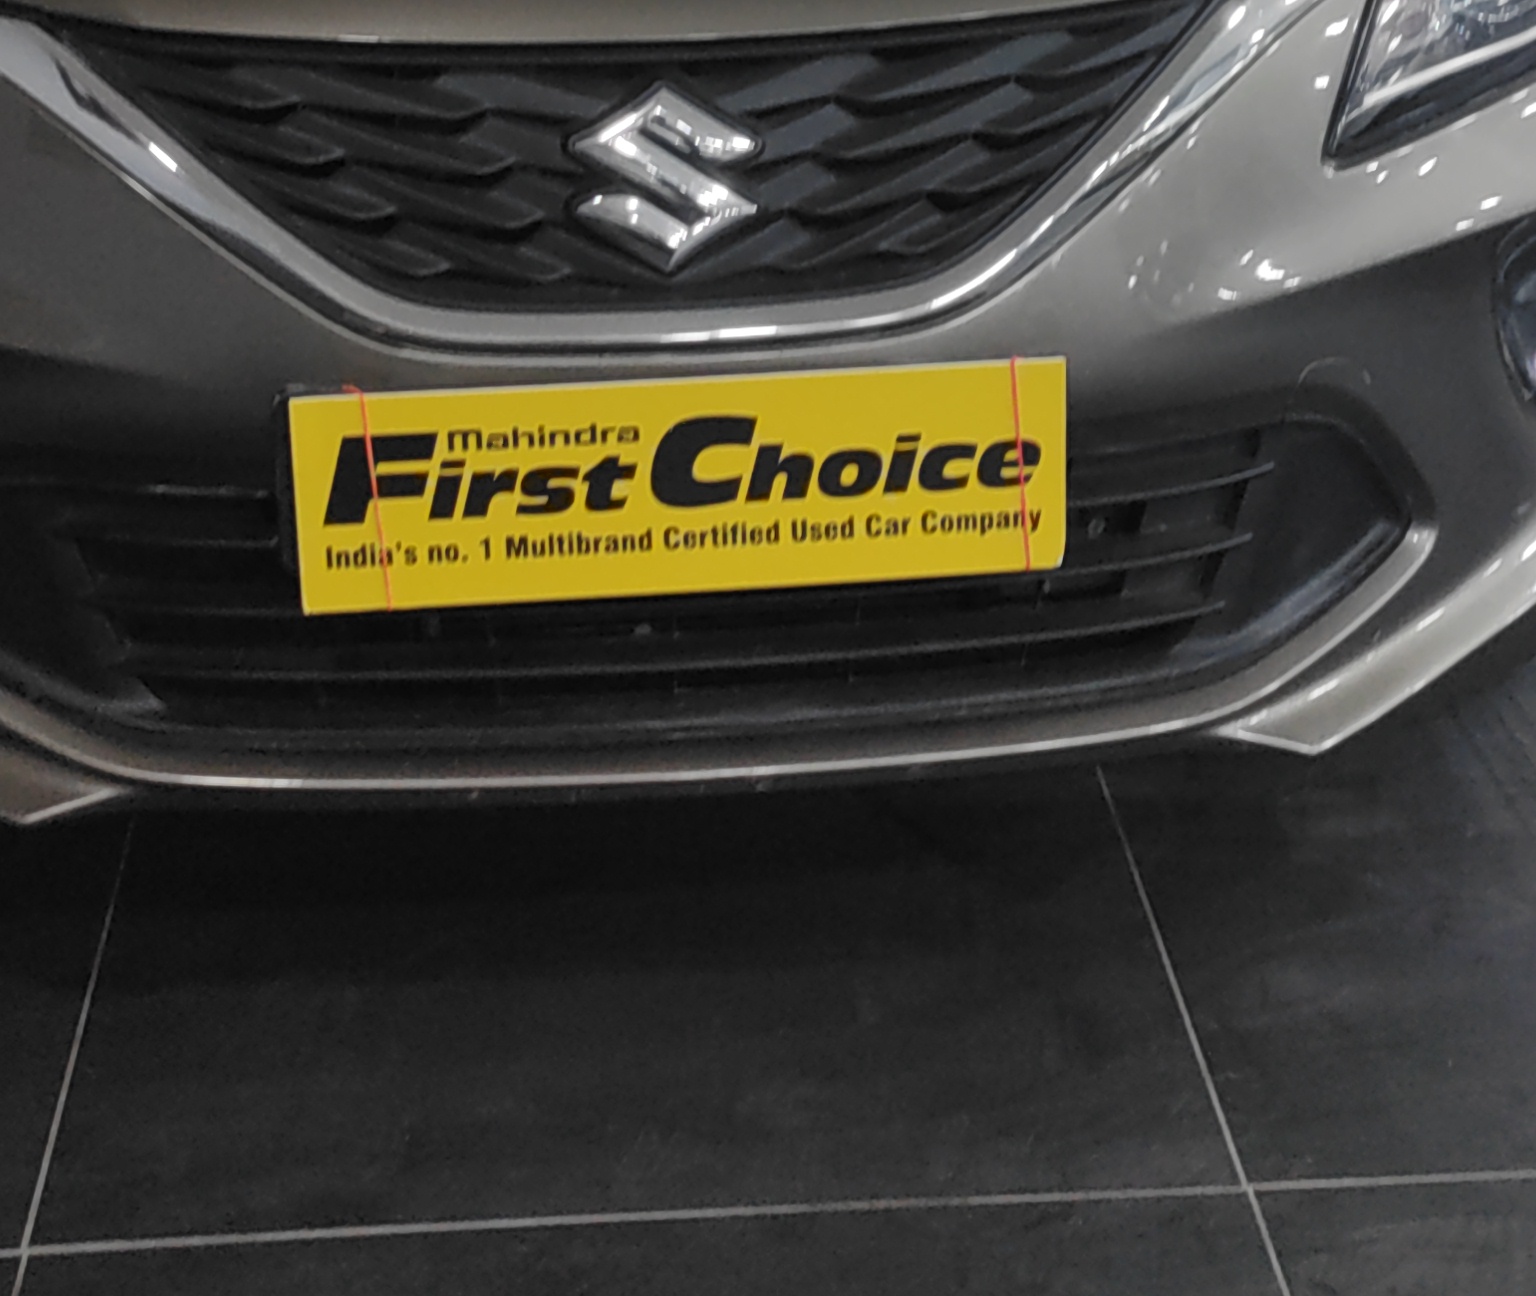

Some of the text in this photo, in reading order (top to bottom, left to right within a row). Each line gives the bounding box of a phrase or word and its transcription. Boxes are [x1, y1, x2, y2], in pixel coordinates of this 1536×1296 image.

[447, 423, 640, 453] Mahindra
[323, 414, 1042, 528] First Choice
[326, 507, 1042, 571] India's no. 1 Multibrand Certified Used Car Company
